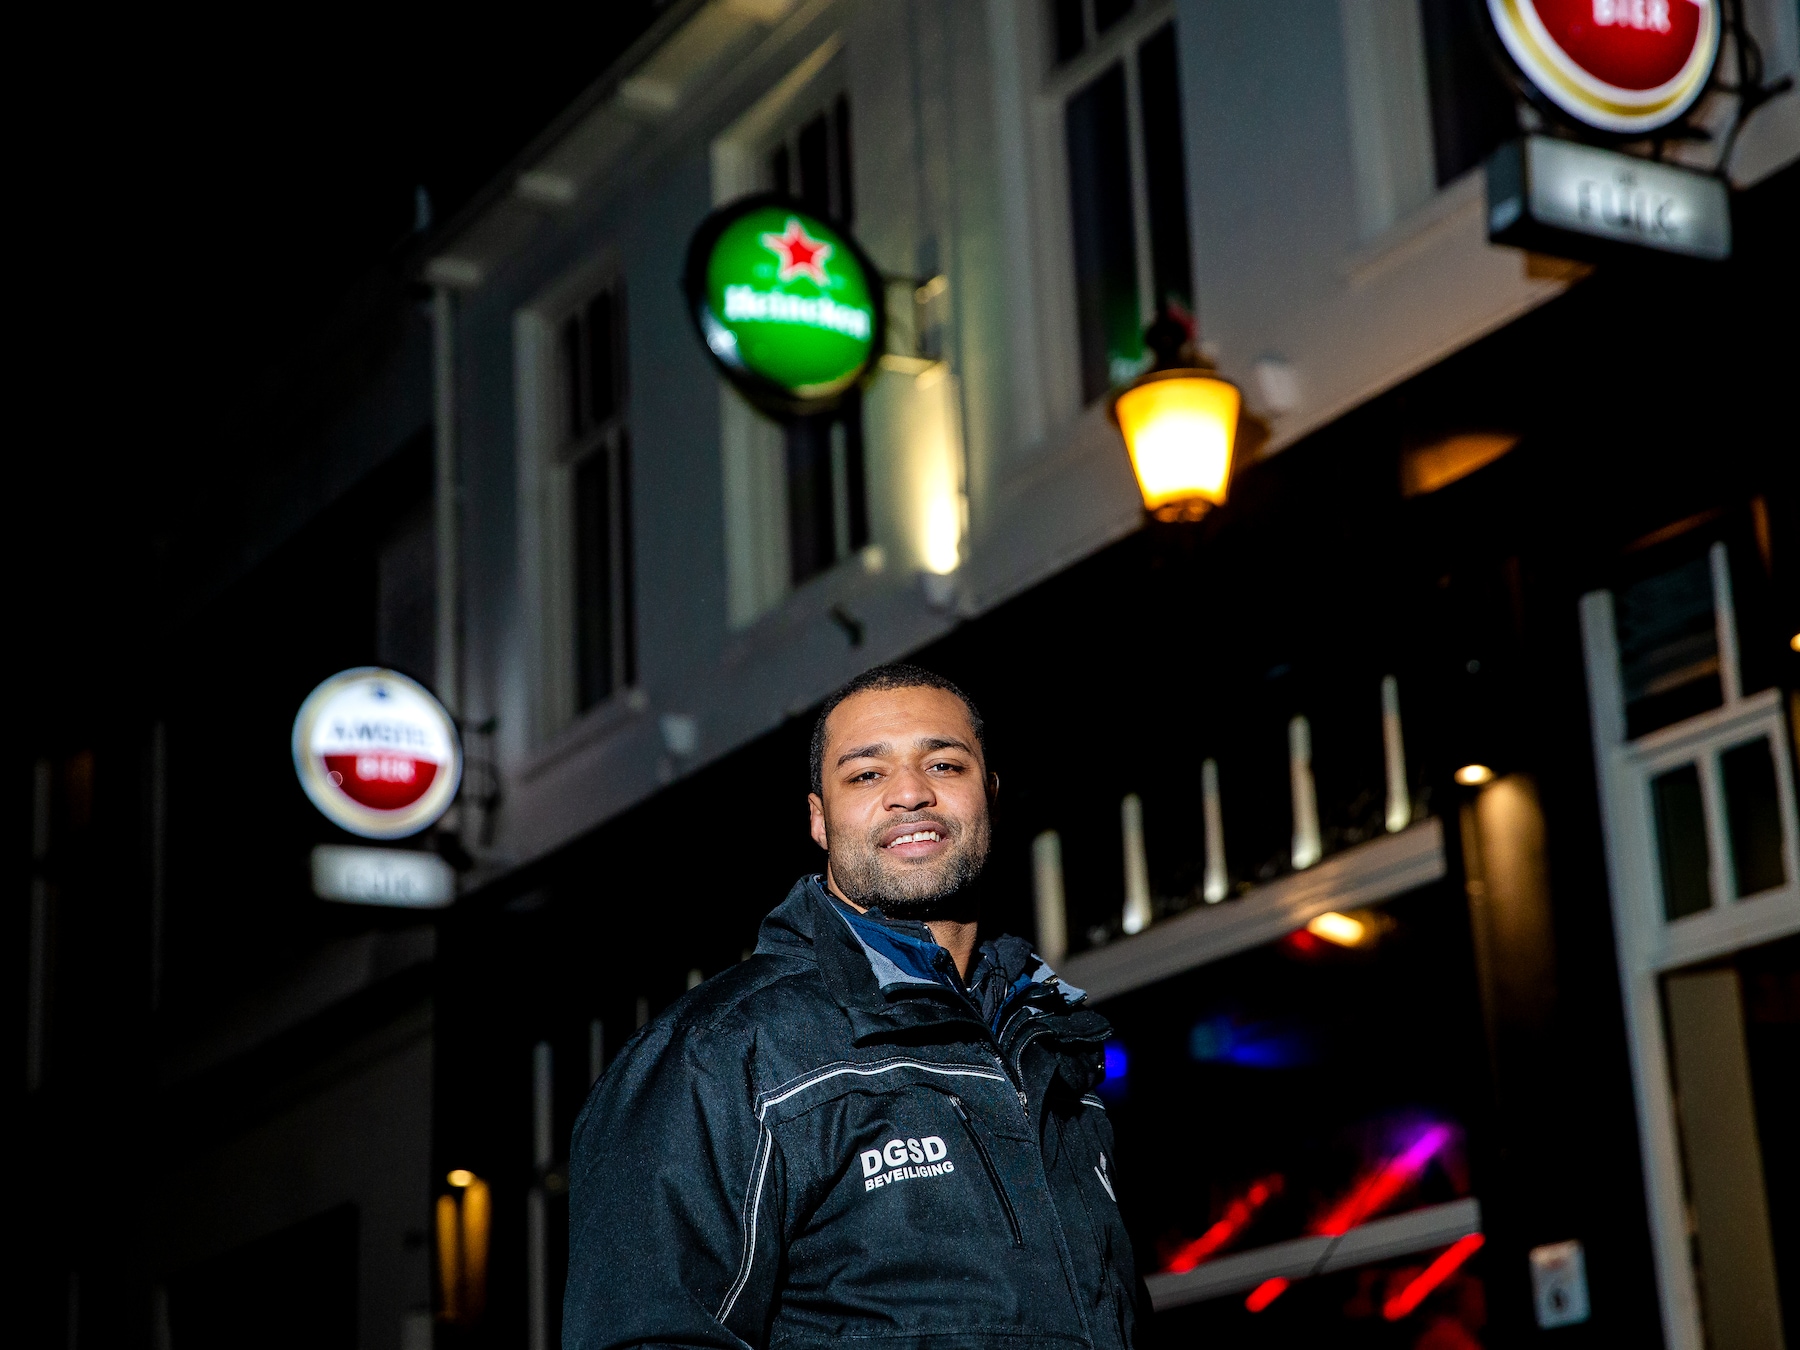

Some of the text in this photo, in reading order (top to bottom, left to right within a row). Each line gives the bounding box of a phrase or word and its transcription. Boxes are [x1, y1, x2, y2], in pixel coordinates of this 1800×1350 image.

[724, 285, 871, 340] Heineken
[860, 1135, 947, 1178] DGSD
[864, 1161, 954, 1192] BEVEILIGING
